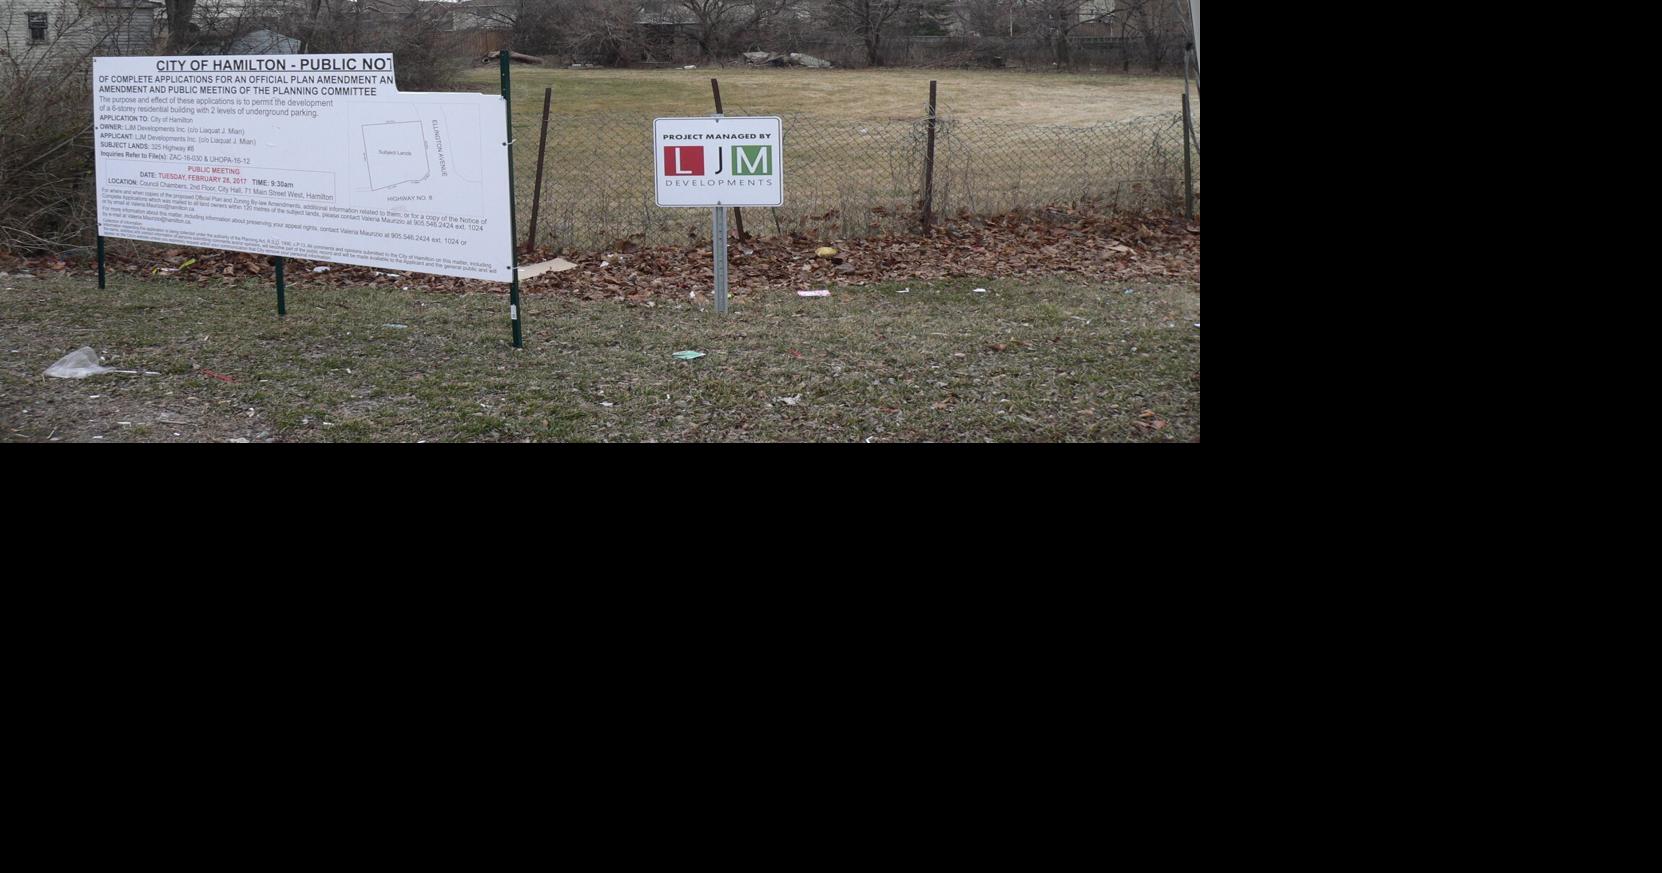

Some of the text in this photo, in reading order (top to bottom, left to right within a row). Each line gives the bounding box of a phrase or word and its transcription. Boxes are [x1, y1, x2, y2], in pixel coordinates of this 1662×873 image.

[156, 60, 187, 71] CITY
[190, 60, 208, 71] OF
[214, 59, 285, 71] HAMILTON
[301, 59, 356, 70] PUBLIC
[99, 75, 109, 83] OF
[111, 75, 152, 83] COMPLETE
[155, 75, 213, 83] APPLICATIONS
[249, 76, 288, 84] OFFICIAL
[291, 76, 315, 84] PLAN
[317, 76, 377, 84] AMENDMENT
[99, 85, 148, 94] AMENDMENT
[150, 86, 166, 94] AND
[168, 86, 197, 94] PUBLIC
[200, 86, 237, 94] MEETING
[254, 87, 270, 95] THE
[273, 87, 318, 95] PLANNING
[321, 87, 376, 96] COMMITTEE
[196, 98, 234, 106] applications
[252, 99, 273, 107] permit
[288, 99, 333, 108] development
[112, 105, 135, 114] 6-storey
[170, 106, 195, 115] building
[246, 108, 289, 117] underground
[291, 109, 319, 118] parking.
[137, 125, 175, 133] Developments
[199, 127, 220, 135] Liaquat
[148, 135, 186, 143] Developments
[439, 153, 448, 176] AVENUE
[159, 173, 187, 181] TUESDAY,
[188, 175, 221, 183] FEBRUARY
[271, 180, 294, 188] 9:30am
[665, 179, 773, 187] DEVELOPMENTS
[108, 178, 138, 186] LOCATION:
[161, 182, 188, 190] Chambers,
[218, 186, 228, 194] City
[288, 191, 304, 199] West,
[306, 192, 333, 200] Hamilton
[286, 208, 304, 216] subject
[329, 205, 358, 213] information
